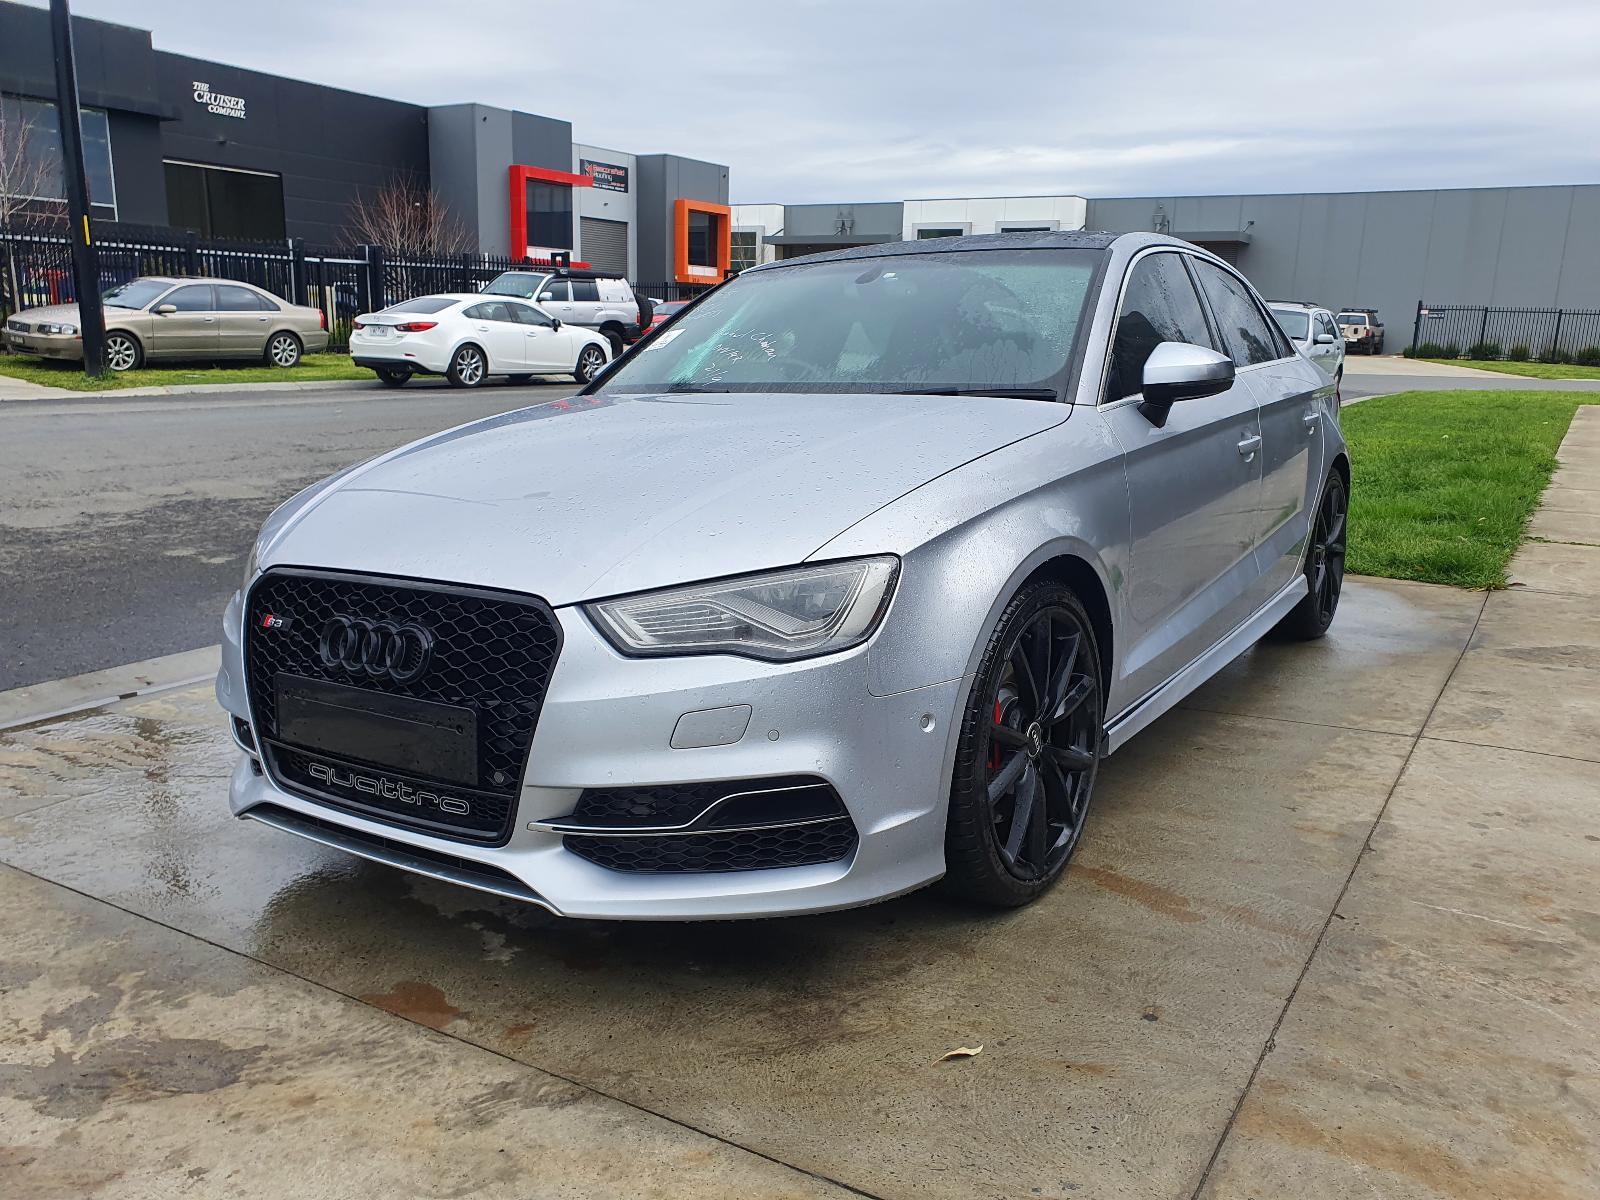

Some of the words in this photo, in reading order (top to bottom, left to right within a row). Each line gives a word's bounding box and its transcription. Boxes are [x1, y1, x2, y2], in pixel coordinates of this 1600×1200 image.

[192, 81, 210, 91] THE
[193, 91, 246, 110] CRUISER
[269, 618, 283, 628] S3
[308, 762, 470, 816] quattro
